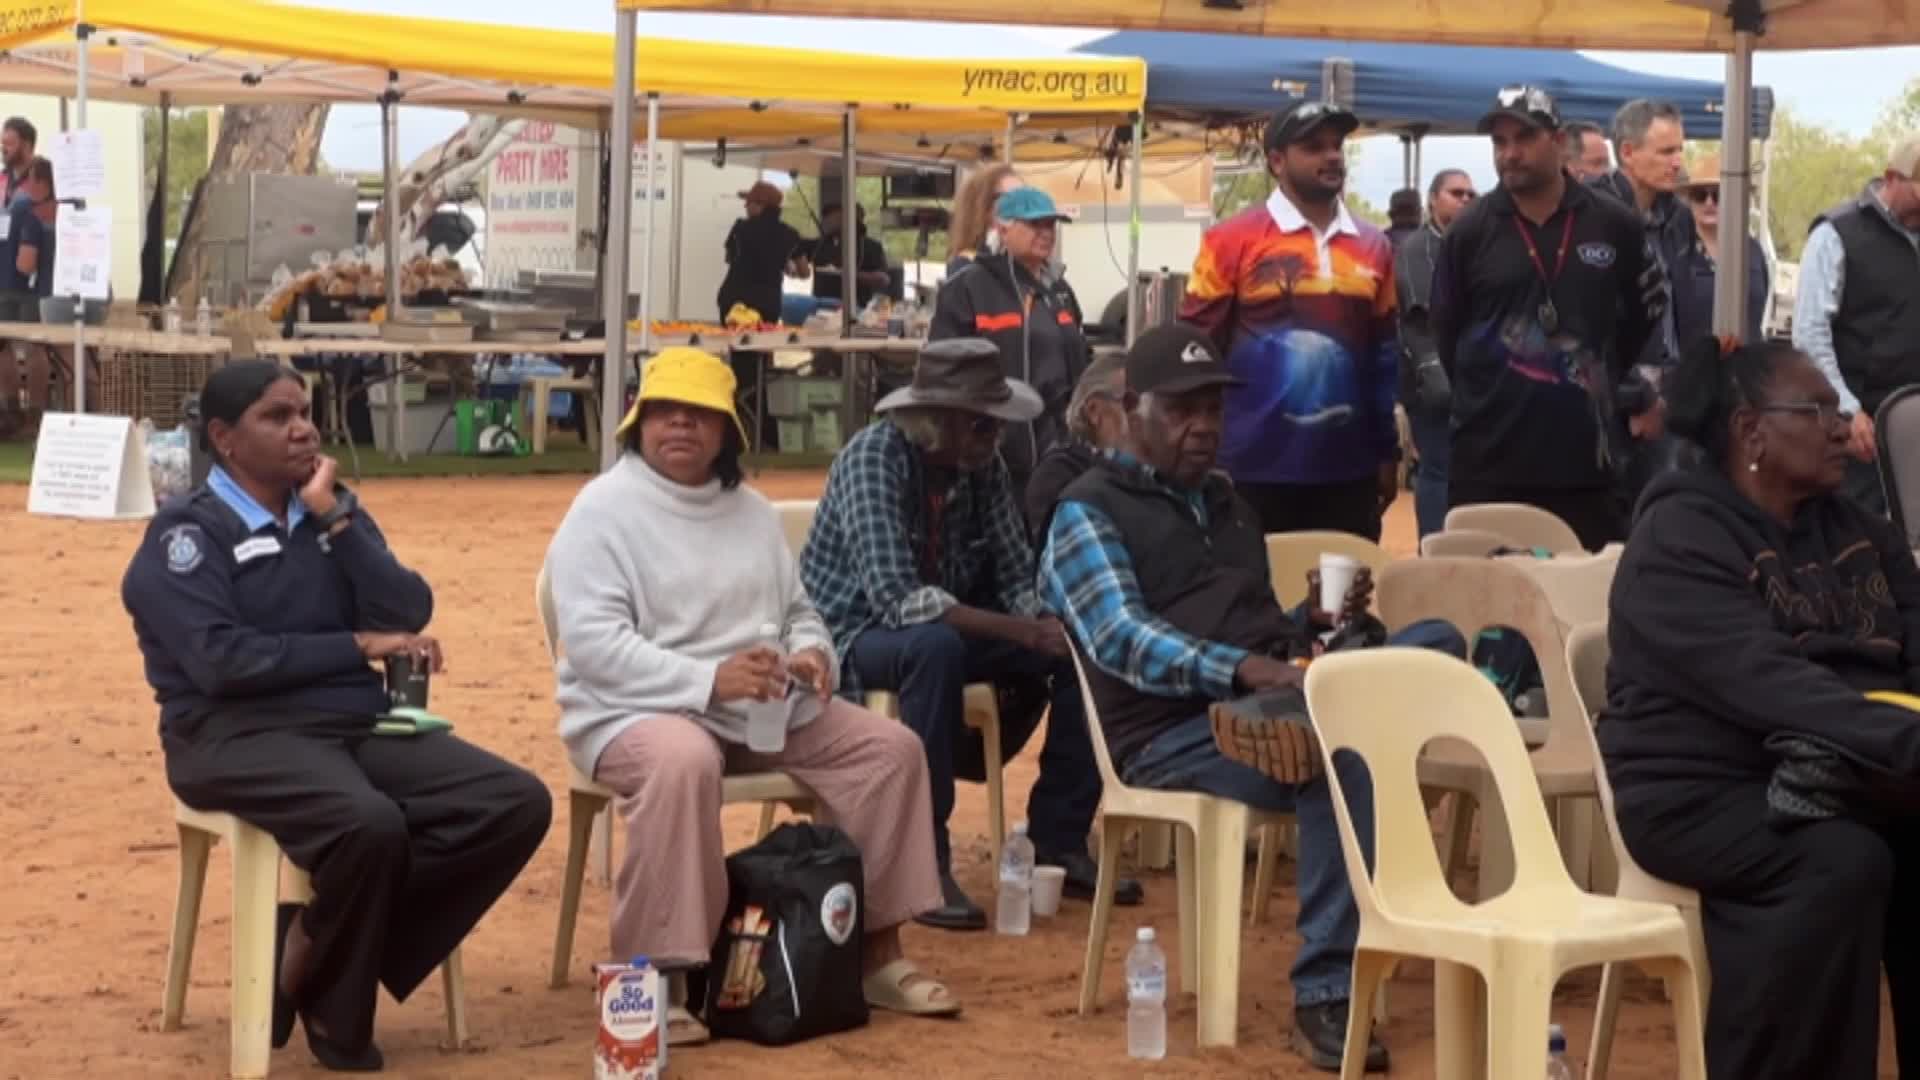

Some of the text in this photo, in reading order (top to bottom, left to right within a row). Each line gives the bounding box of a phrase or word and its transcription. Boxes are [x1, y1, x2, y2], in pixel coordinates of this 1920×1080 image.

[962, 68, 1128, 101] ymac.org.au
[496, 147, 569, 184] PARTY HIRE
[622, 984, 643, 999] So
[609, 997, 654, 1013] Good
